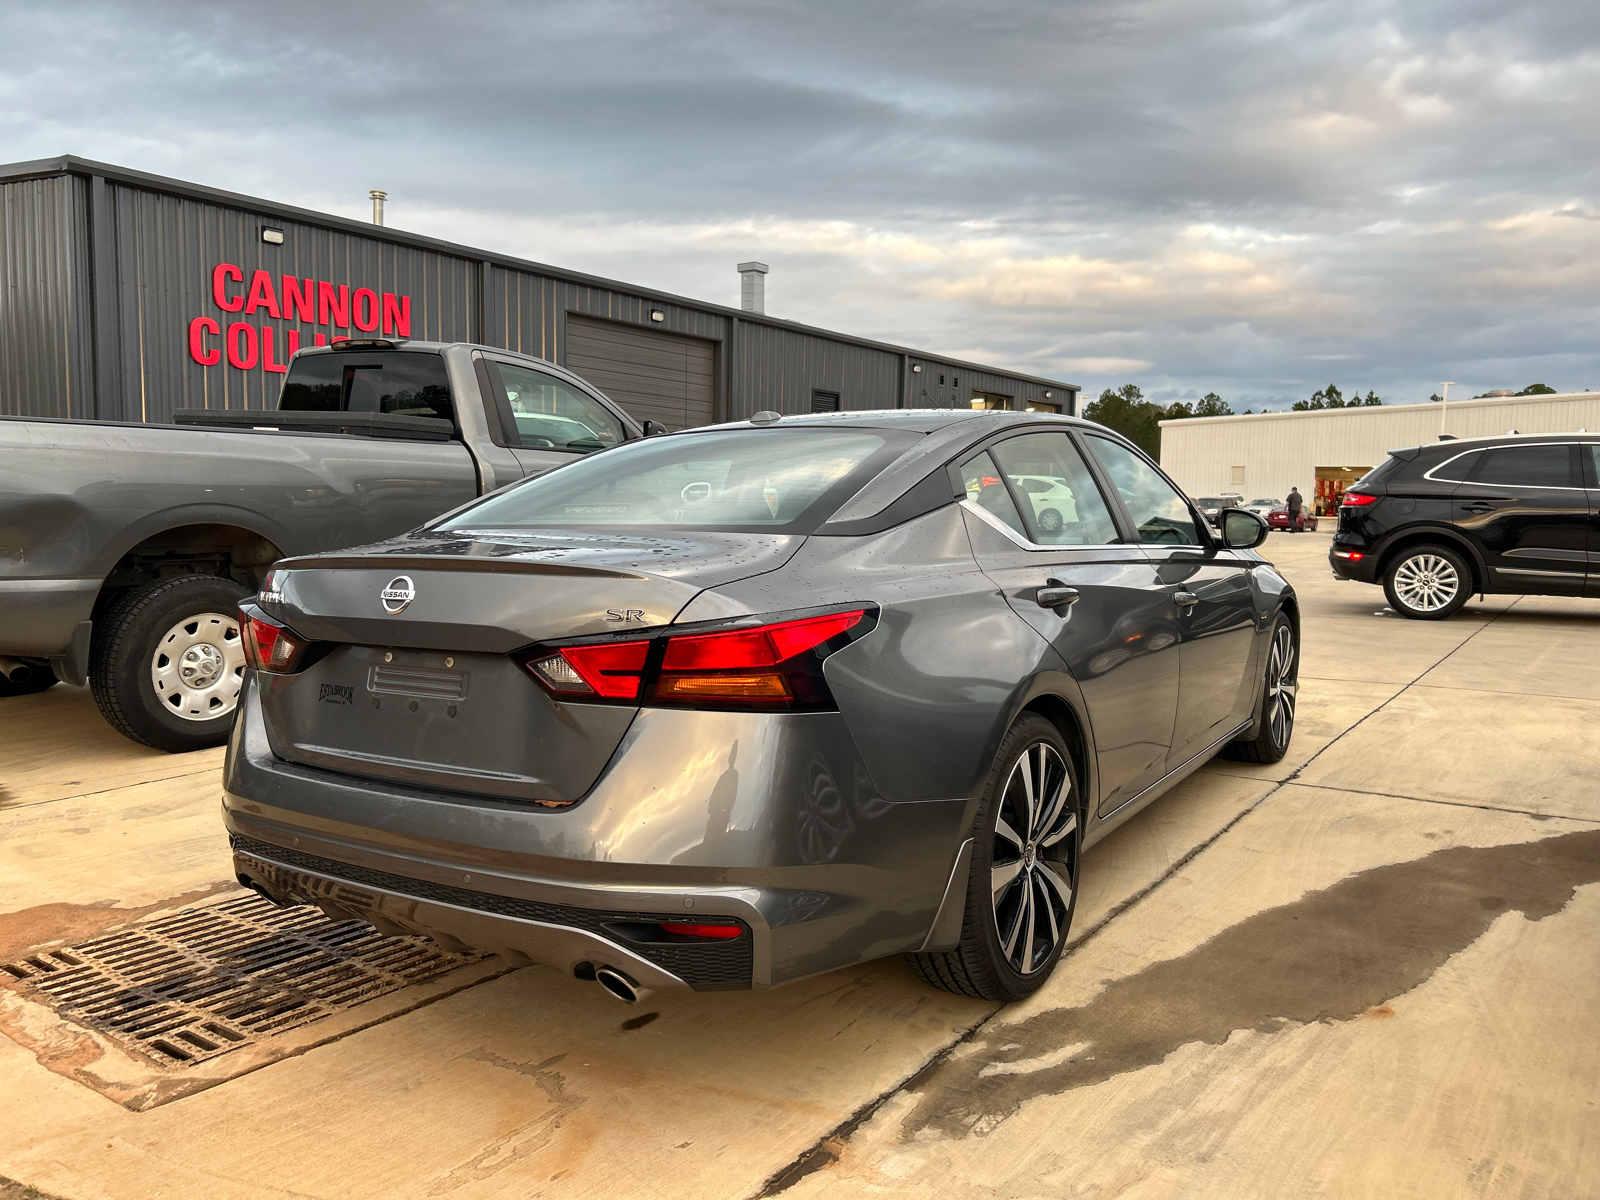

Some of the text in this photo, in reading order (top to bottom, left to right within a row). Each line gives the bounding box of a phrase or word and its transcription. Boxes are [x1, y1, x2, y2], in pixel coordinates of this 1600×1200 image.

[213, 263, 411, 337] CANNON
[605, 608, 645, 622] SR
[318, 683, 355, 705] ESTABROOK
